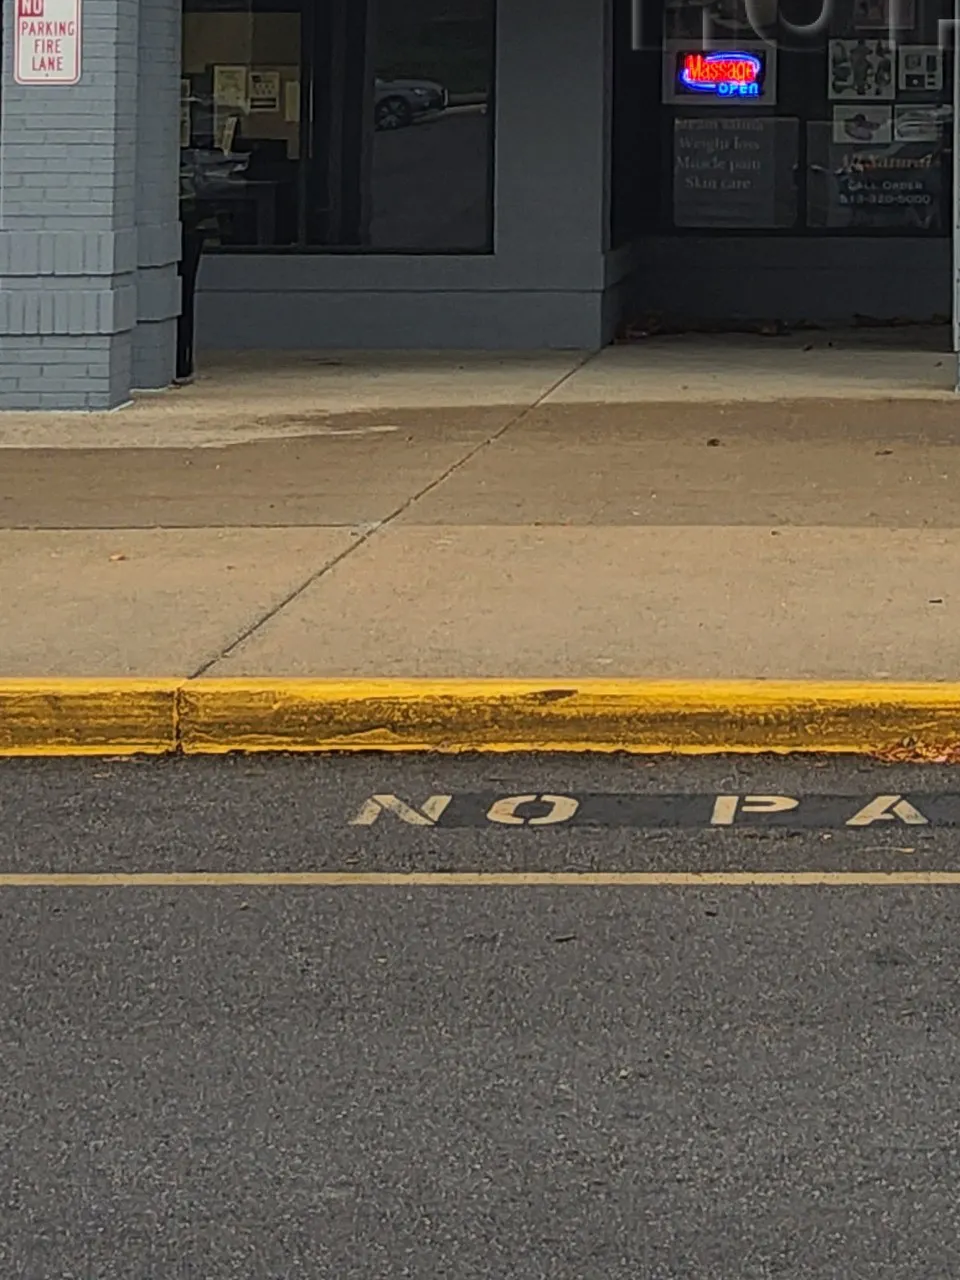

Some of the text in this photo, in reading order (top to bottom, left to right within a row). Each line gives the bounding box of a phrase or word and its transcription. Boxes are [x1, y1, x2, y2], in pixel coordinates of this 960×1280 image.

[21, 20, 75, 37] PARKING
[34, 39, 62, 54] FIRE
[32, 56, 64, 72] LANE
[347, 793, 583, 827] NO
